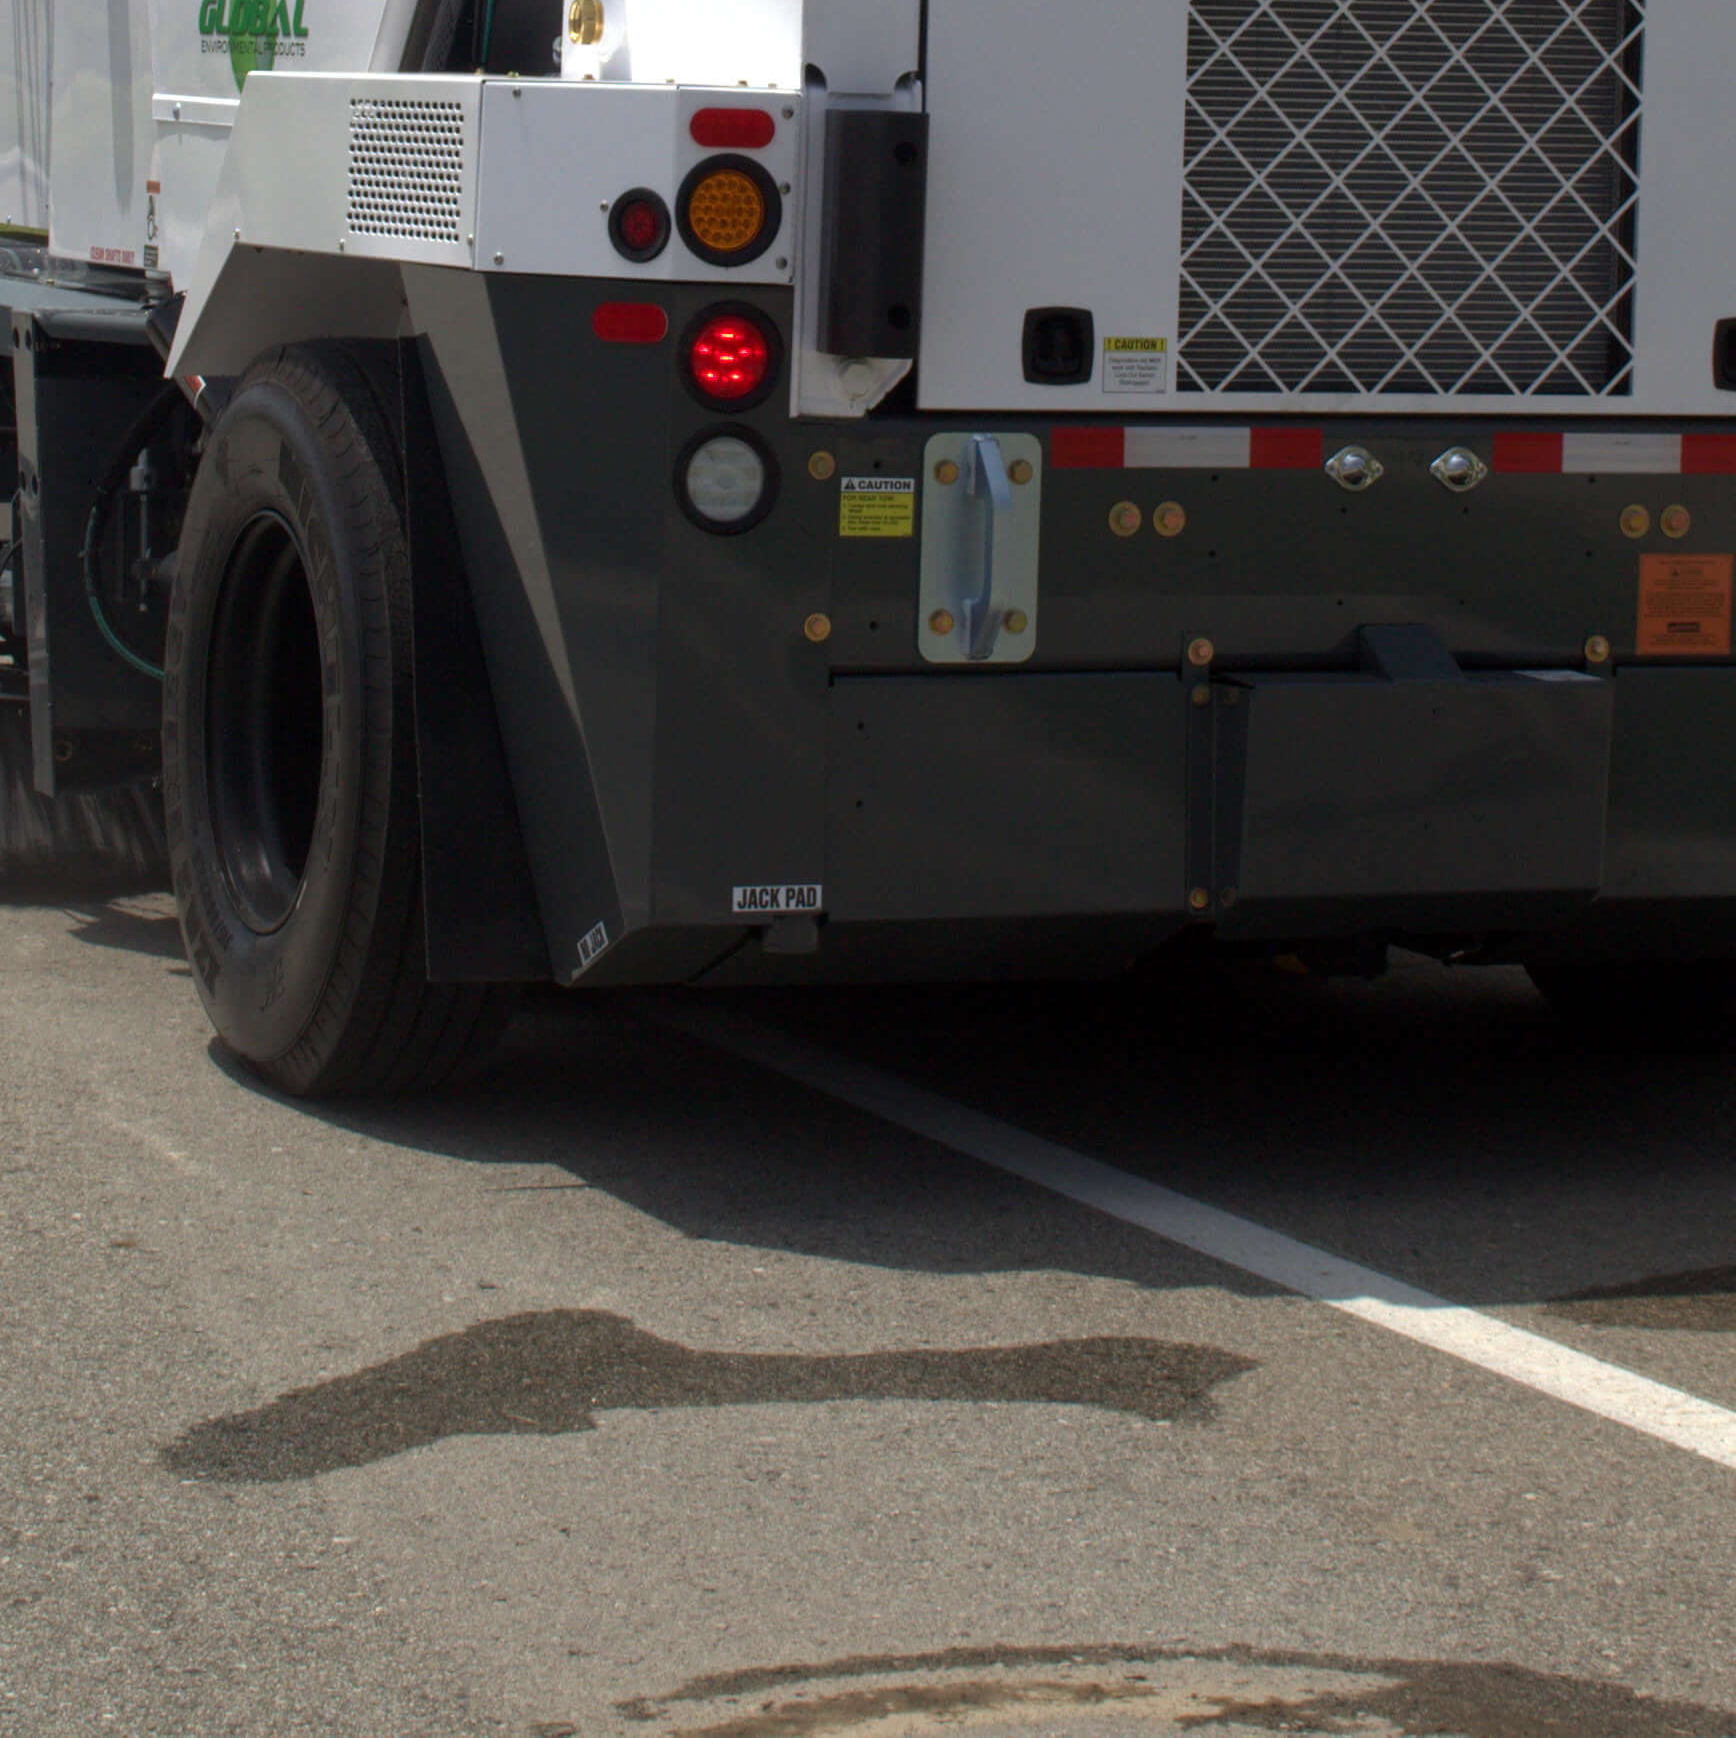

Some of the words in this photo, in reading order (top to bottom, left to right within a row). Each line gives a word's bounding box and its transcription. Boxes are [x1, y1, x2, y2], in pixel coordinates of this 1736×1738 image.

[1114, 338, 1157, 351] CAUTION
[858, 480, 911, 490] CAUTION
[737, 887, 780, 909] JACK
[785, 887, 817, 908] PAD
